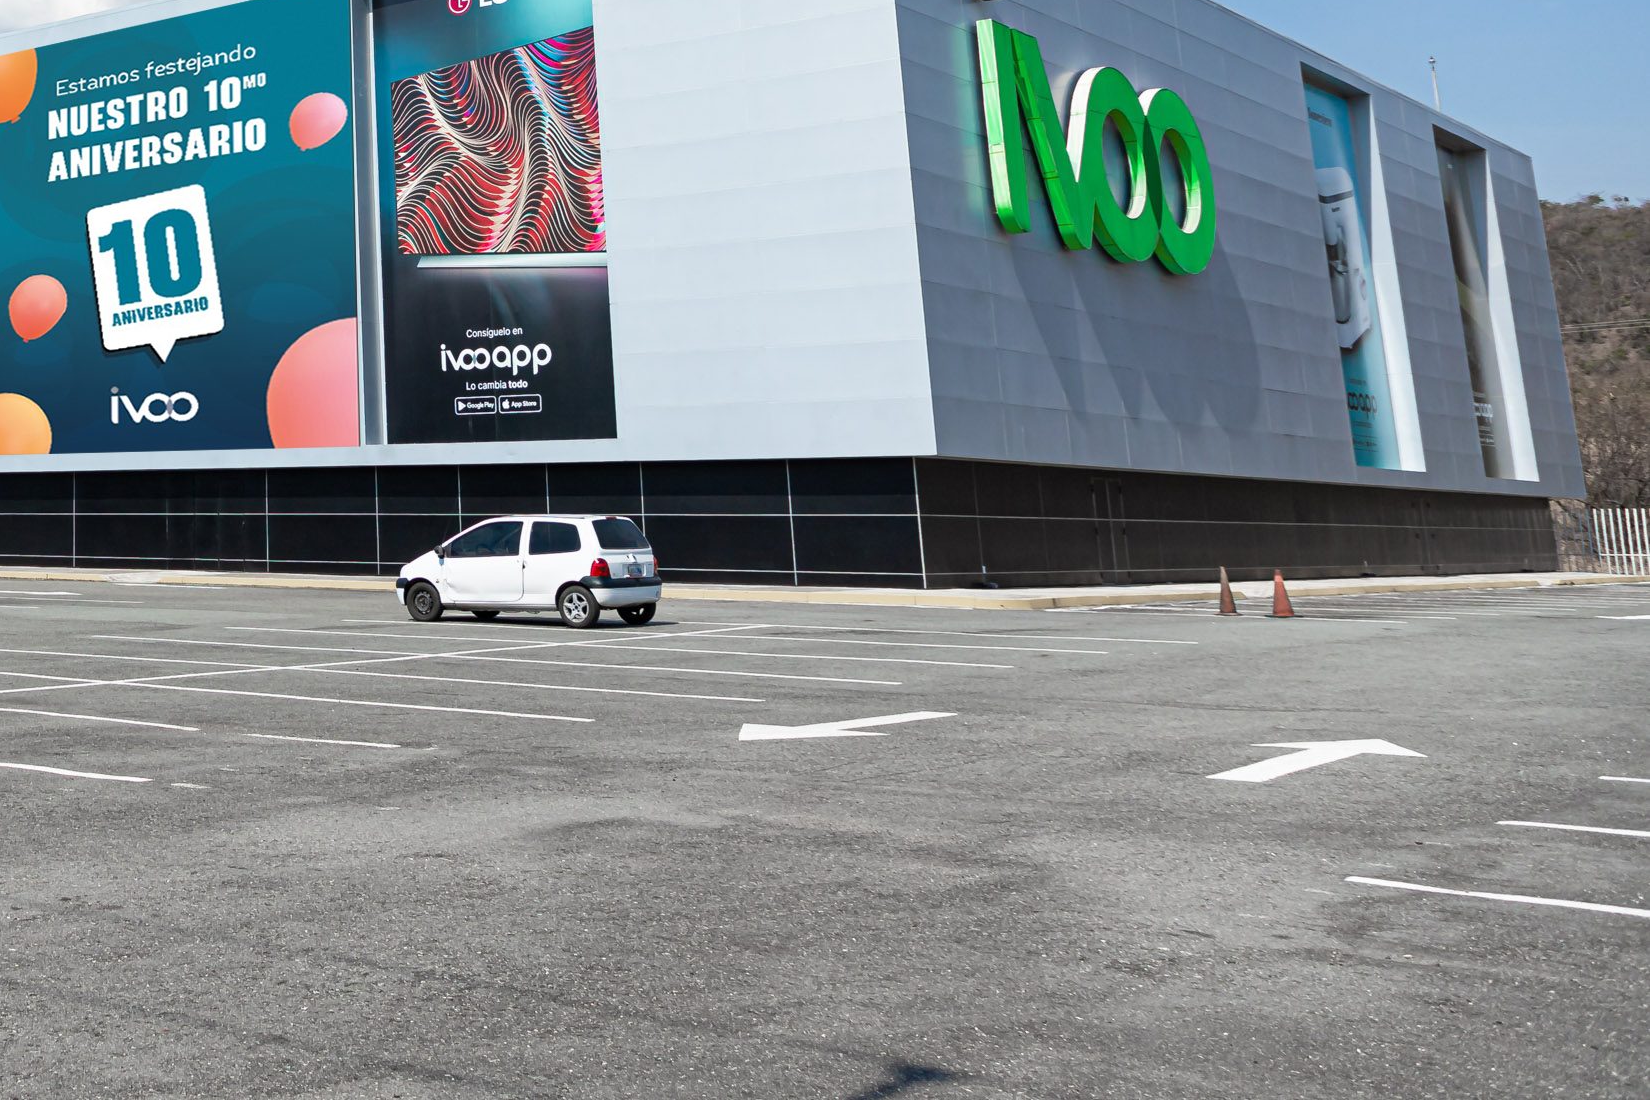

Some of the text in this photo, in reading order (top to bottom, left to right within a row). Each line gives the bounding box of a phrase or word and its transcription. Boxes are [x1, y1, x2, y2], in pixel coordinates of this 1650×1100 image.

[56, 44, 256, 96] Estamos festejando
[48, 86, 188, 140] NUESTRO
[48, 117, 266, 182] ANIVERSARIO
[98, 208, 202, 306] 10
[112, 296, 209, 327] ANIVERSARIO
[466, 327, 510, 338] Consíguelo
[110, 386, 199, 424] ivoo
[466, 380, 528, 390] Lo cambia todo
